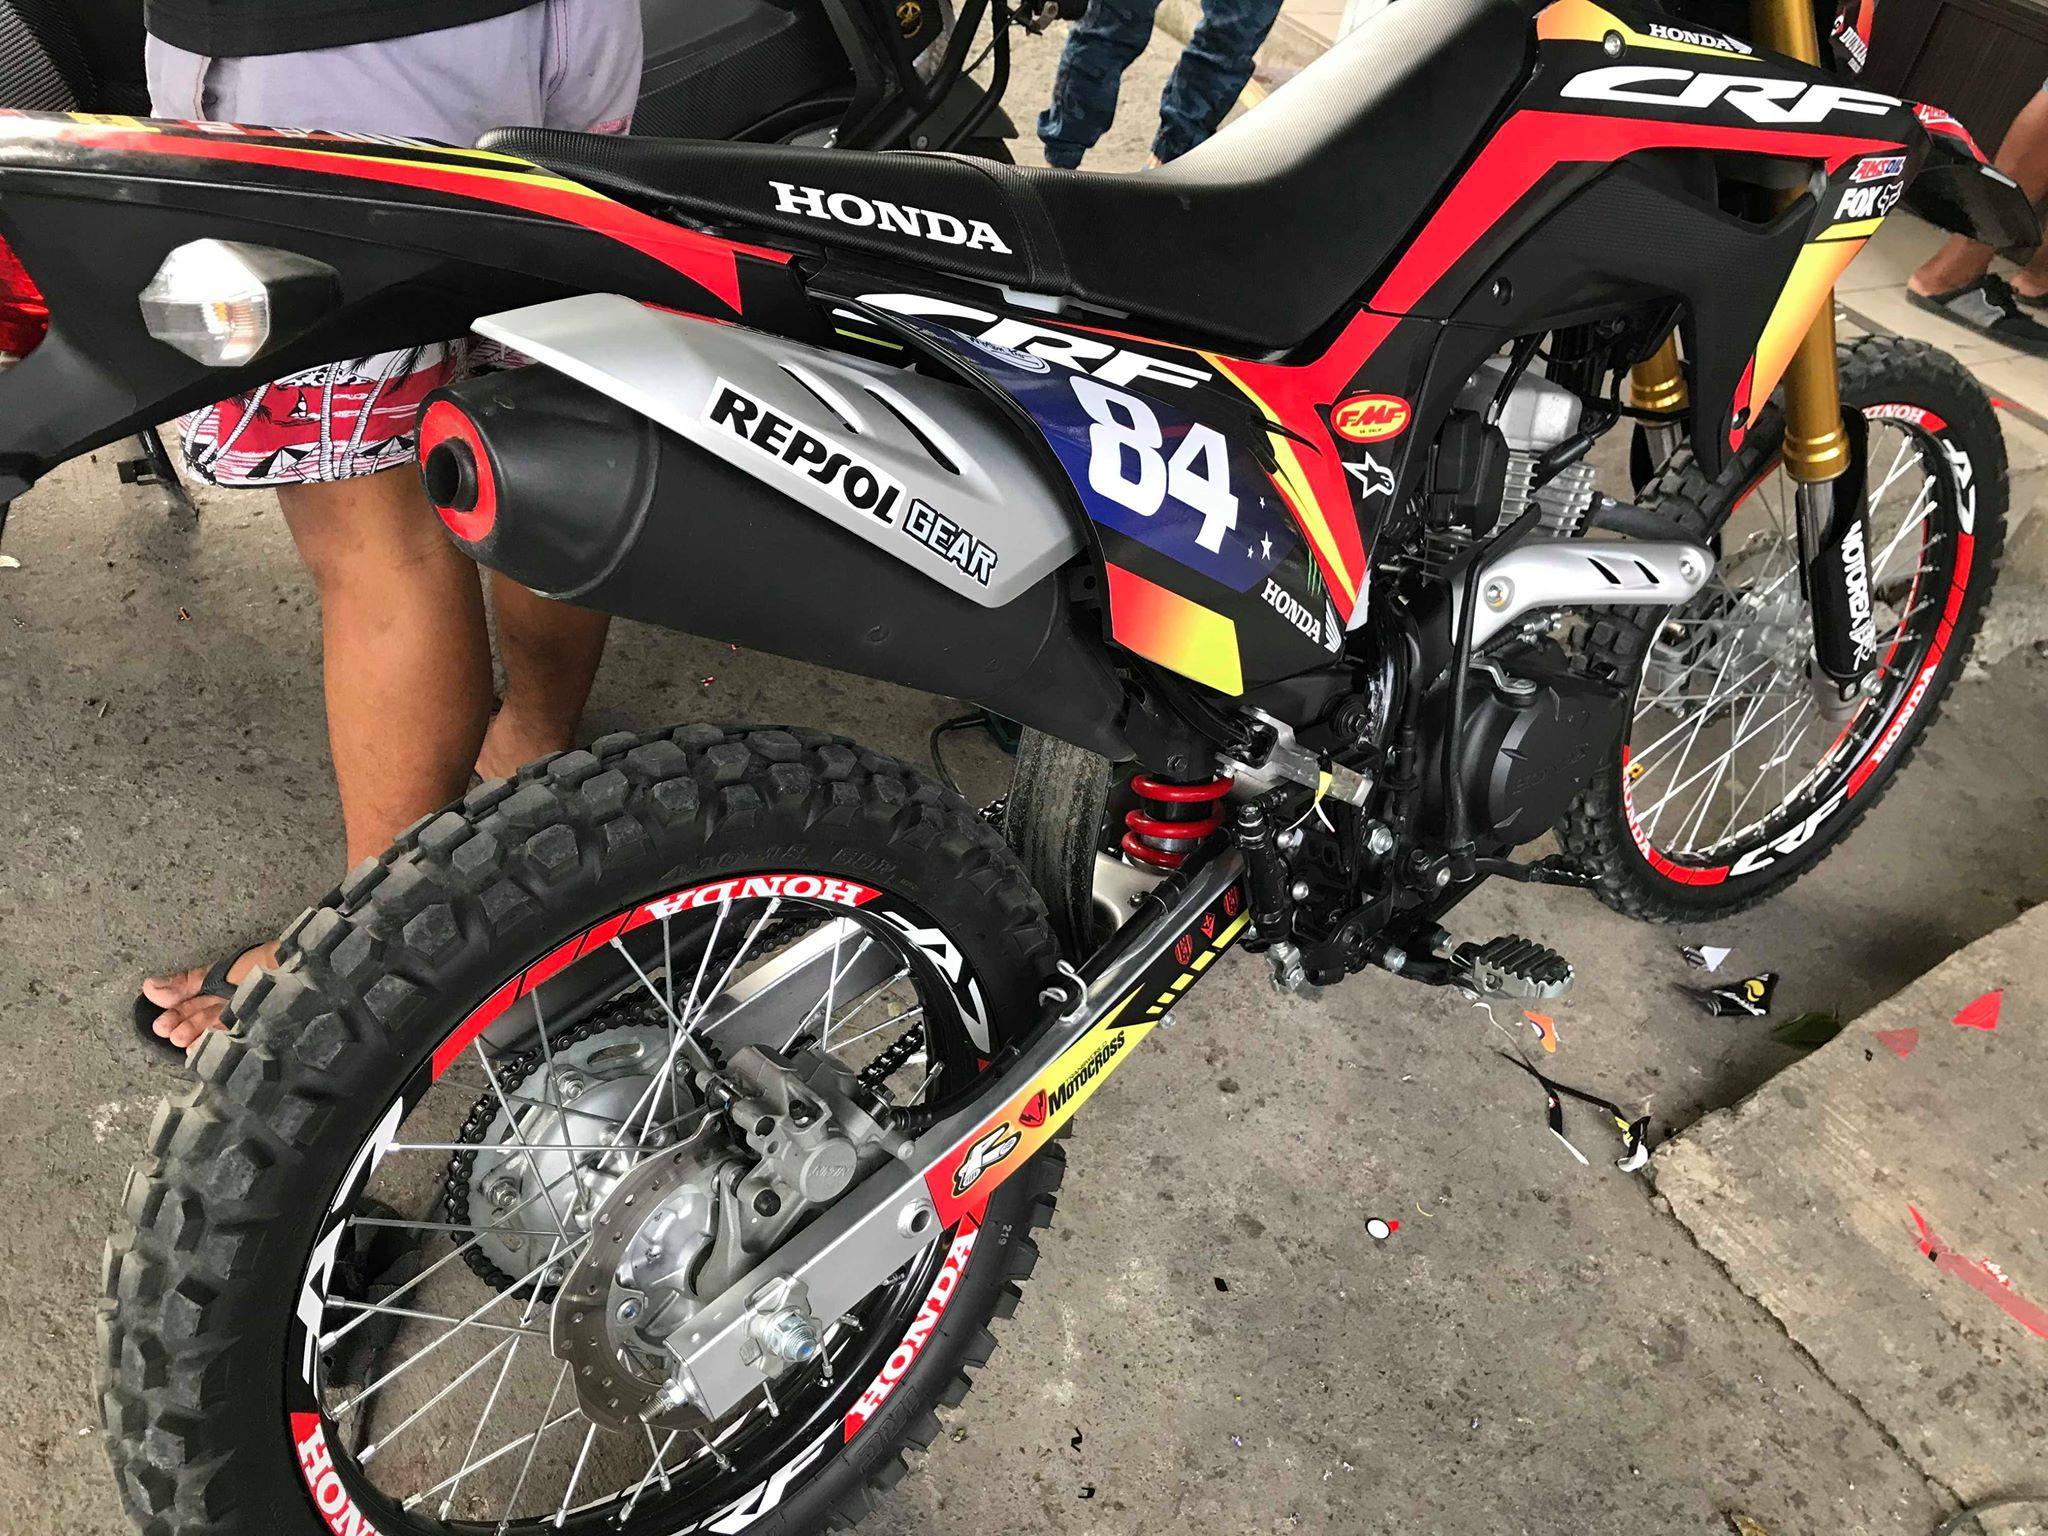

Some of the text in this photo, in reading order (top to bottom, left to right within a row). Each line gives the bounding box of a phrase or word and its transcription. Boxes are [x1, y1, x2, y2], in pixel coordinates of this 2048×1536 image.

[1649, 24, 1735, 51] HONDA
[1560, 65, 1902, 123] CRF
[1833, 185, 1884, 220] FOX
[1850, 156, 1907, 183] AMSOIL
[769, 181, 1013, 254] HONDA
[832, 293, 1212, 389] CRF
[1339, 404, 1406, 427] FMF
[1862, 404, 1927, 426] HOND
[710, 386, 998, 590] REPSOL GEAR
[1070, 375, 1240, 555] 84
[1261, 577, 1321, 644] HONDA
[1873, 664, 1938, 762] HONDA
[1729, 784, 1850, 876] CRF
[644, 876, 864, 919] HONDA
[849, 1229, 980, 1421] HONDA
[299, 1423, 385, 1536] HON
[668, 1419, 839, 1536] RF
